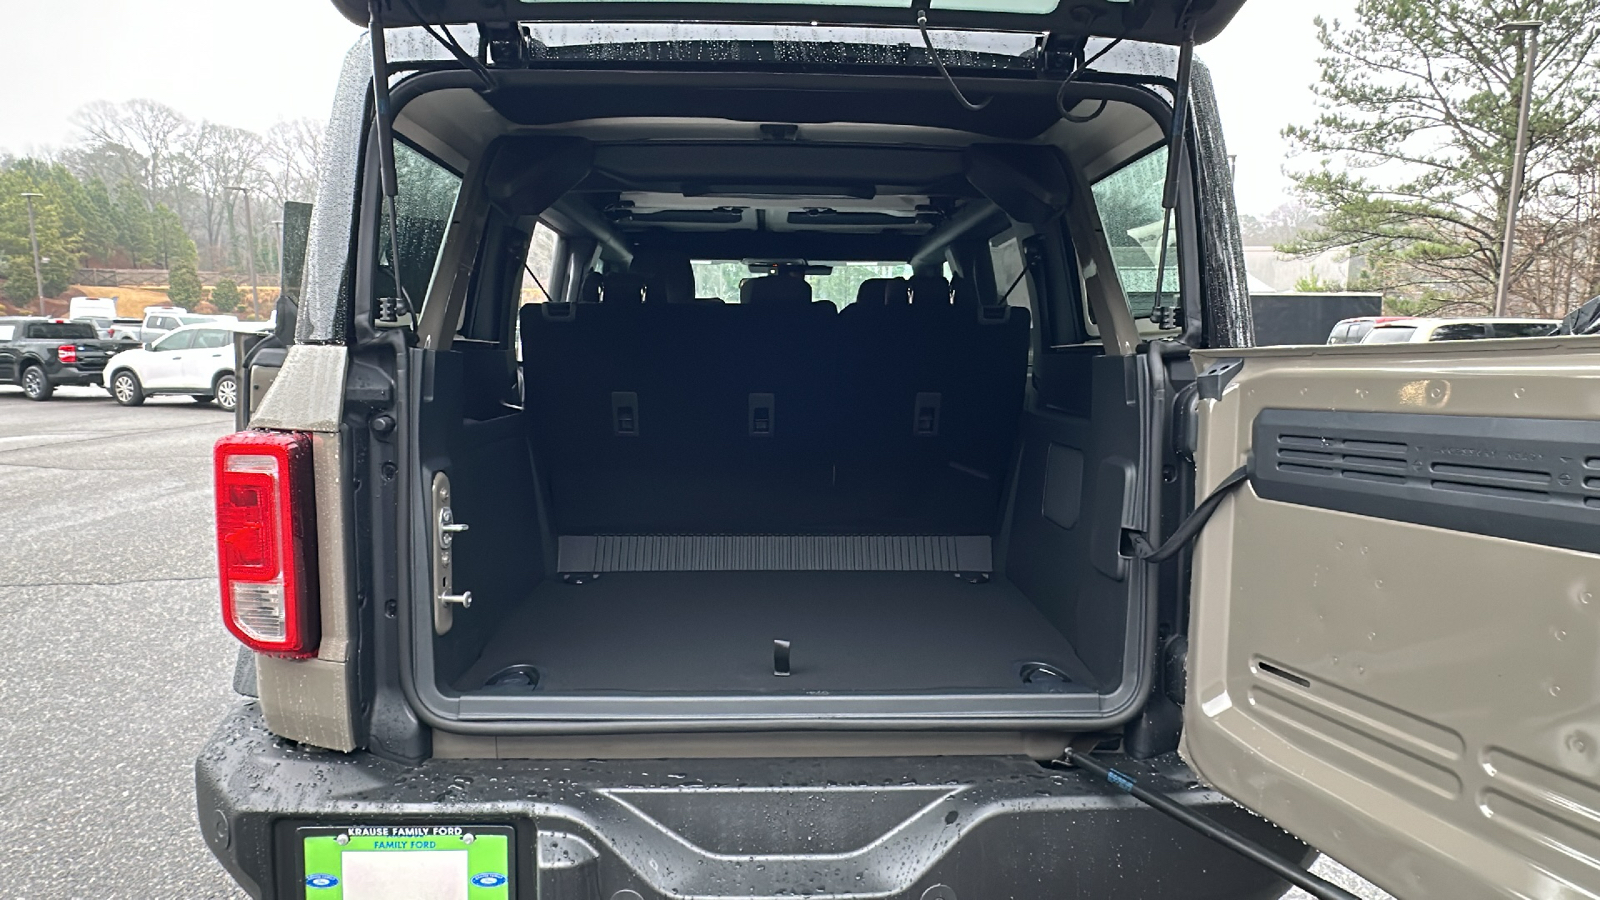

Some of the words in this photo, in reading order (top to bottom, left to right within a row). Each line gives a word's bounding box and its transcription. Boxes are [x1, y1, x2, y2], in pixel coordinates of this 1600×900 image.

[348, 827, 389, 836] KRAUSE
[392, 827, 429, 836] FAMILY
[433, 827, 463, 836] FORD
[374, 841, 407, 849] FAMILY
[410, 841, 436, 849] FORD
